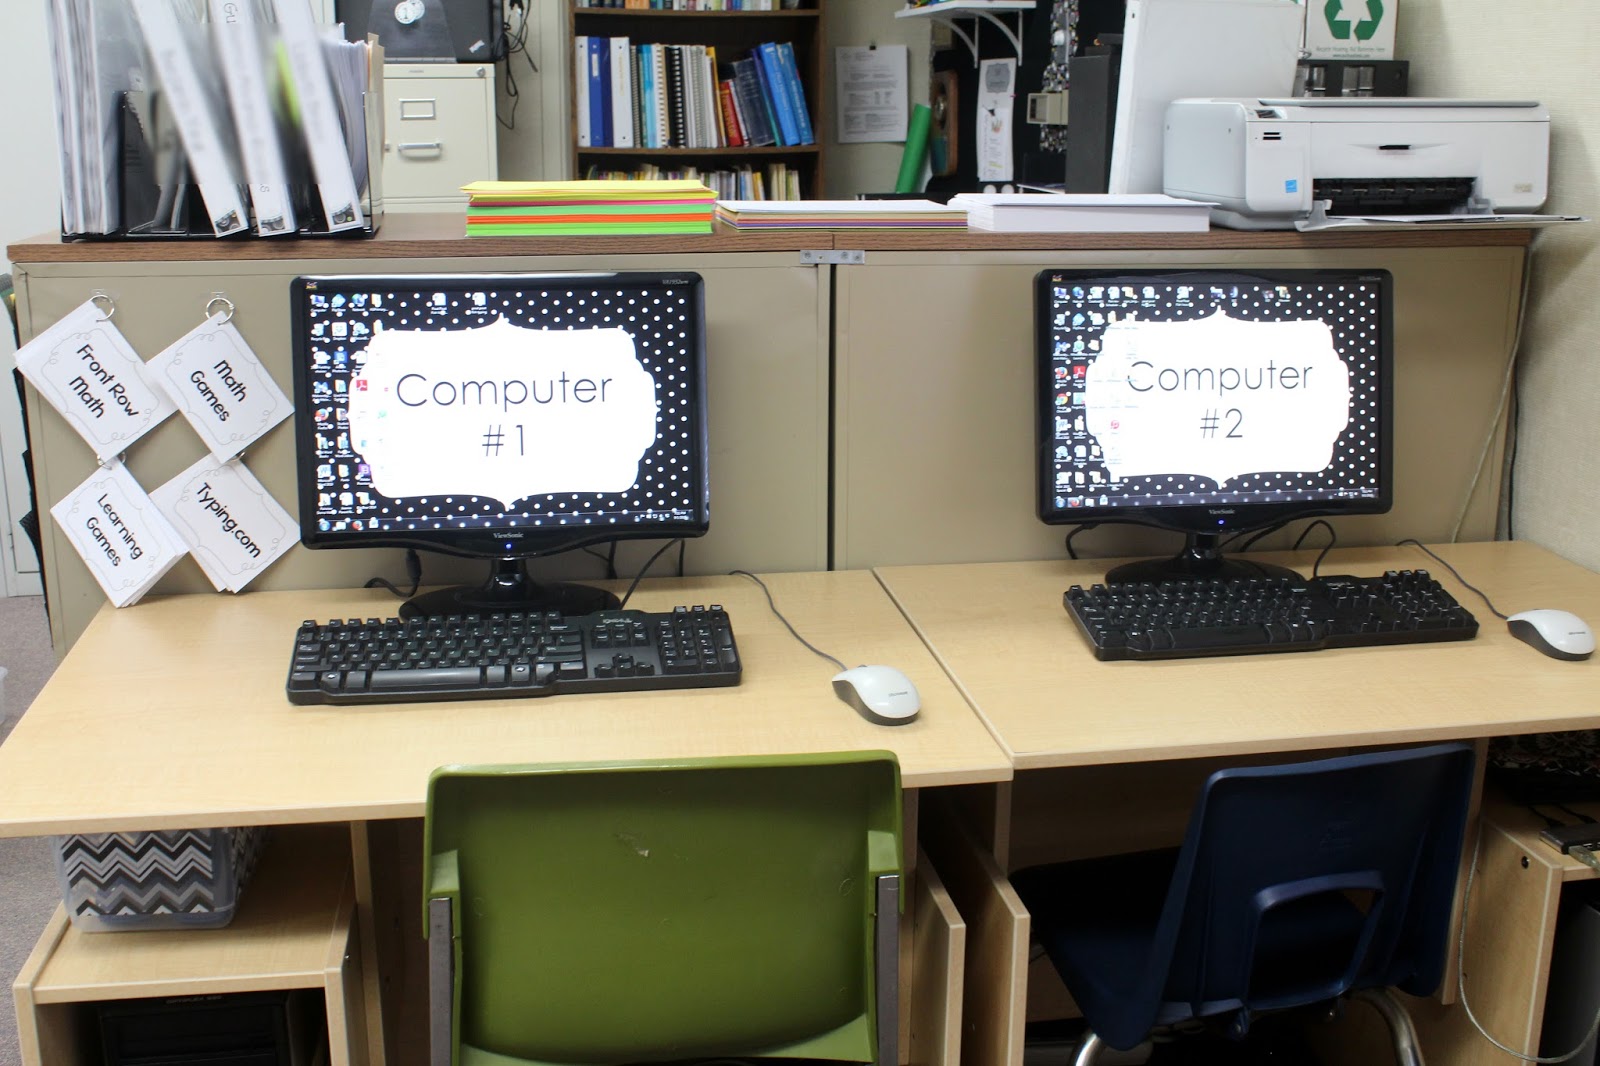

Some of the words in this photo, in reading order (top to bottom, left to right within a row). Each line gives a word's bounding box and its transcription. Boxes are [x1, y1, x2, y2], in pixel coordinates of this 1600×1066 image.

[69, 376, 105, 418] Math
[77, 344, 115, 385] Front
[108, 382, 139, 417] Row
[190, 370, 230, 422] Games
[213, 359, 247, 402] Math
[396, 371, 613, 412] Computer
[1127, 360, 1313, 397] Computer
[482, 424, 524, 457] #1
[1200, 408, 1243, 438] #2
[86, 516, 121, 567] Games
[97, 493, 143, 560] Learning
[197, 482, 261, 559] Typing.com
